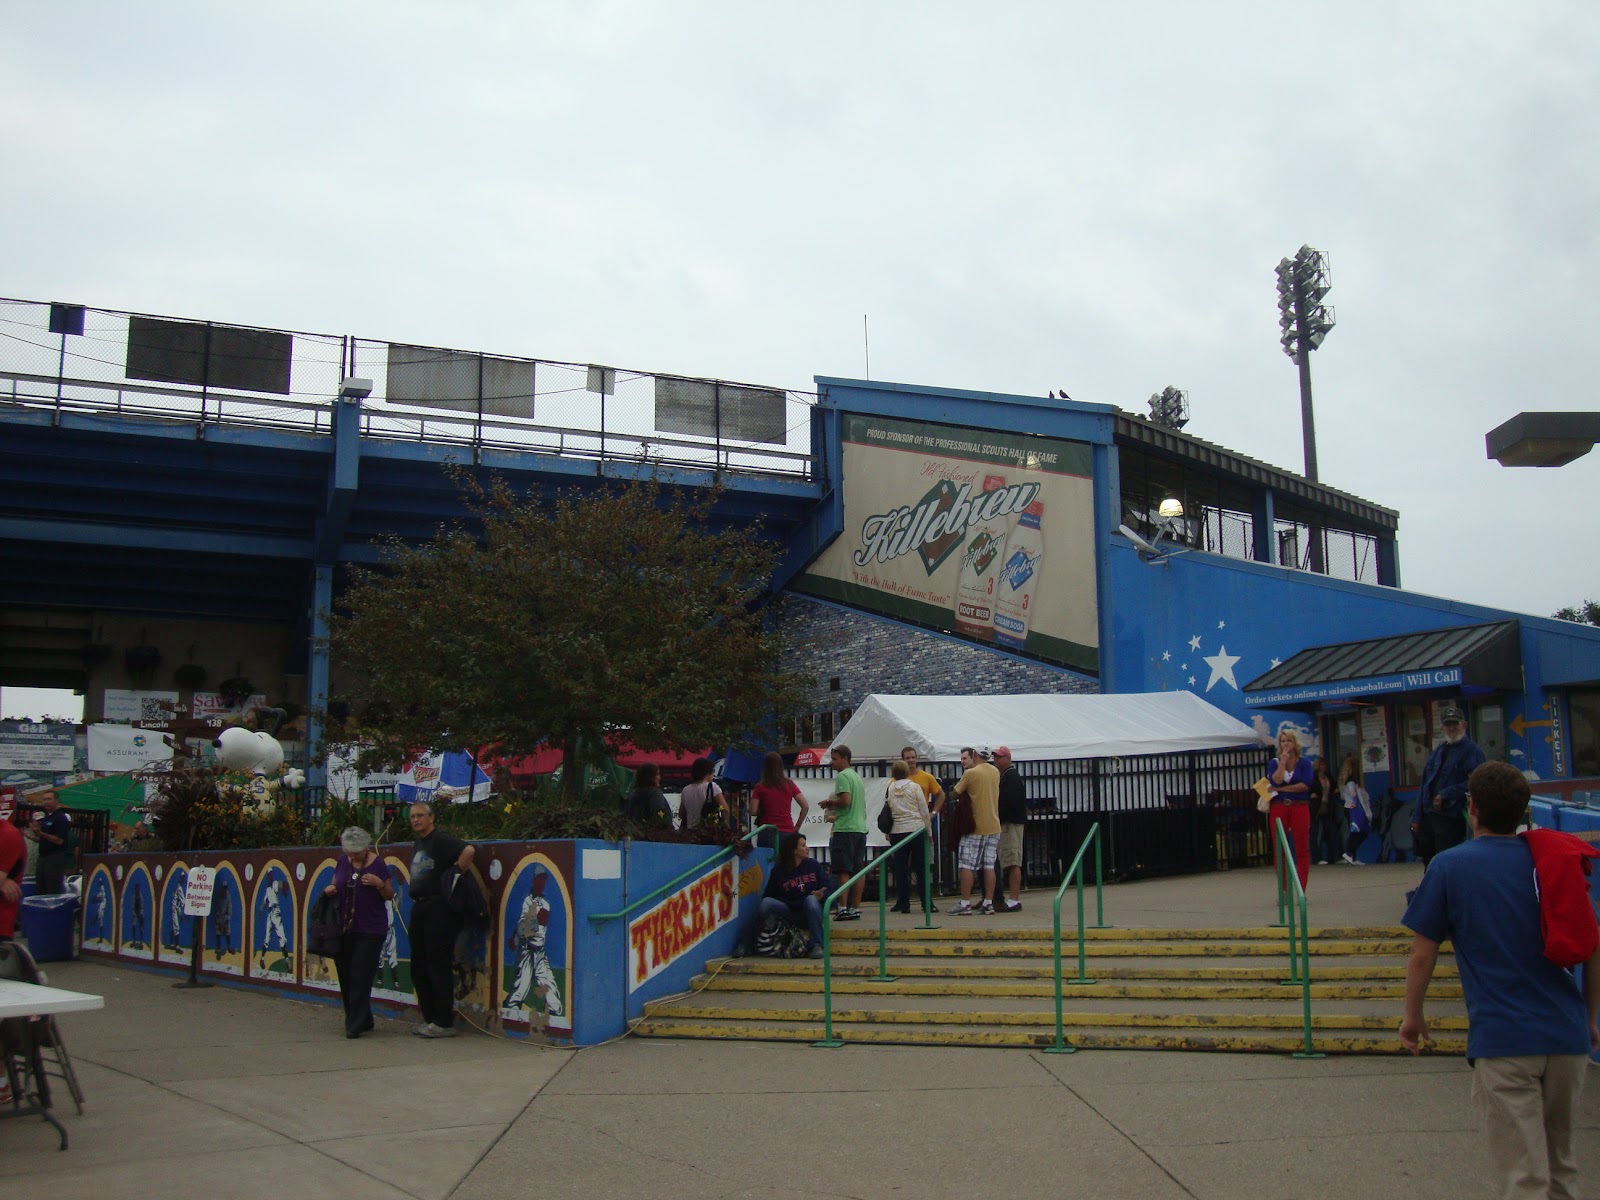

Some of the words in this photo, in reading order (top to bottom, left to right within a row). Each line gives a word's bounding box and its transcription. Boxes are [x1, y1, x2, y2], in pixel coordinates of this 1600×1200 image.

[867, 429, 886, 439] PROUD
[887, 432, 913, 443] SPONSOR
[914, 436, 924, 445] OF
[924, 436, 935, 446] THE
[935, 438, 981, 454] PROFESSIONAL
[982, 444, 1008, 457] SCOUTS
[1009, 448, 1026, 459] HALL
[1038, 452, 1058, 463] FAME
[854, 483, 1040, 566] Killebrew
[870, 576, 880, 587] the
[882, 580, 897, 592] Hall
[898, 584, 906, 595] of
[906, 586, 926, 599] Fame
[988, 577, 994, 594] 3
[1022, 594, 1029, 610] 3
[960, 605, 975, 616] ROOT
[976, 607, 990, 618] BEER
[995, 616, 1010, 626] CREAM
[1010, 620, 1024, 631] SODA
[1407, 673, 1431, 685] Will
[1434, 670, 1458, 683] Call
[1245, 696, 1266, 704] Order
[1268, 693, 1293, 702] tickets
[1294, 690, 1318, 699] online
[1319, 689, 1327, 697] at
[1328, 681, 1402, 695] saintsbaseball.com
[19, 724, 48, 733] G&B
[140, 720, 168, 729] Lincoln
[207, 719, 222, 728] 438
[1552, 696, 1562, 773] TICKETS
[188, 882, 212, 891] Parking
[630, 861, 733, 984] TICKETS
